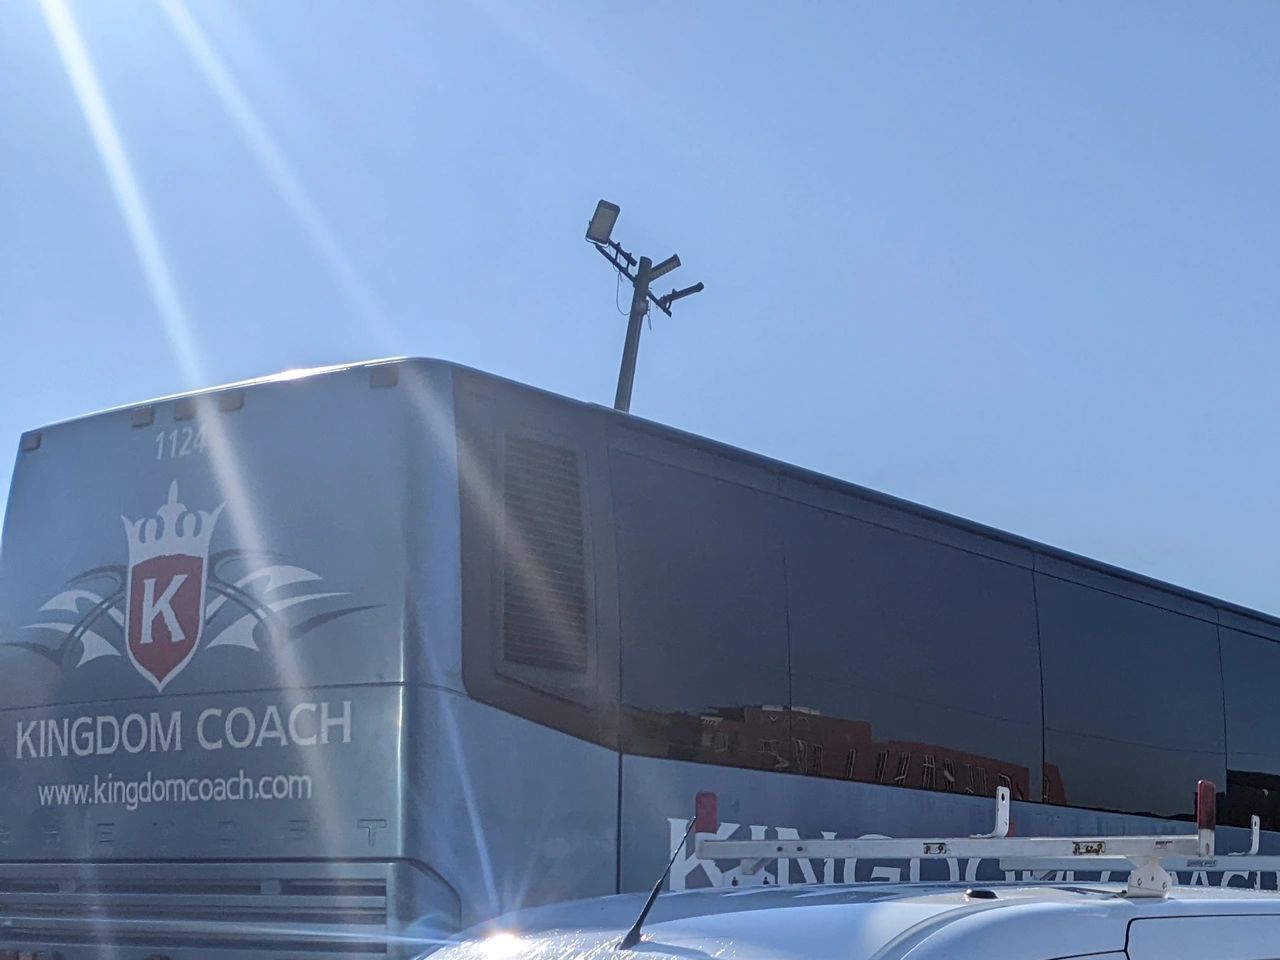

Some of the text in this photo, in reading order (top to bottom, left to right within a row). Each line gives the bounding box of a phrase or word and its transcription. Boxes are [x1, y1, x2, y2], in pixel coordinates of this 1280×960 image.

[140, 574, 188, 644] K
[16, 700, 352, 760] KINGDOM COACH
[38, 770, 313, 811] www.kingdomcoach.com
